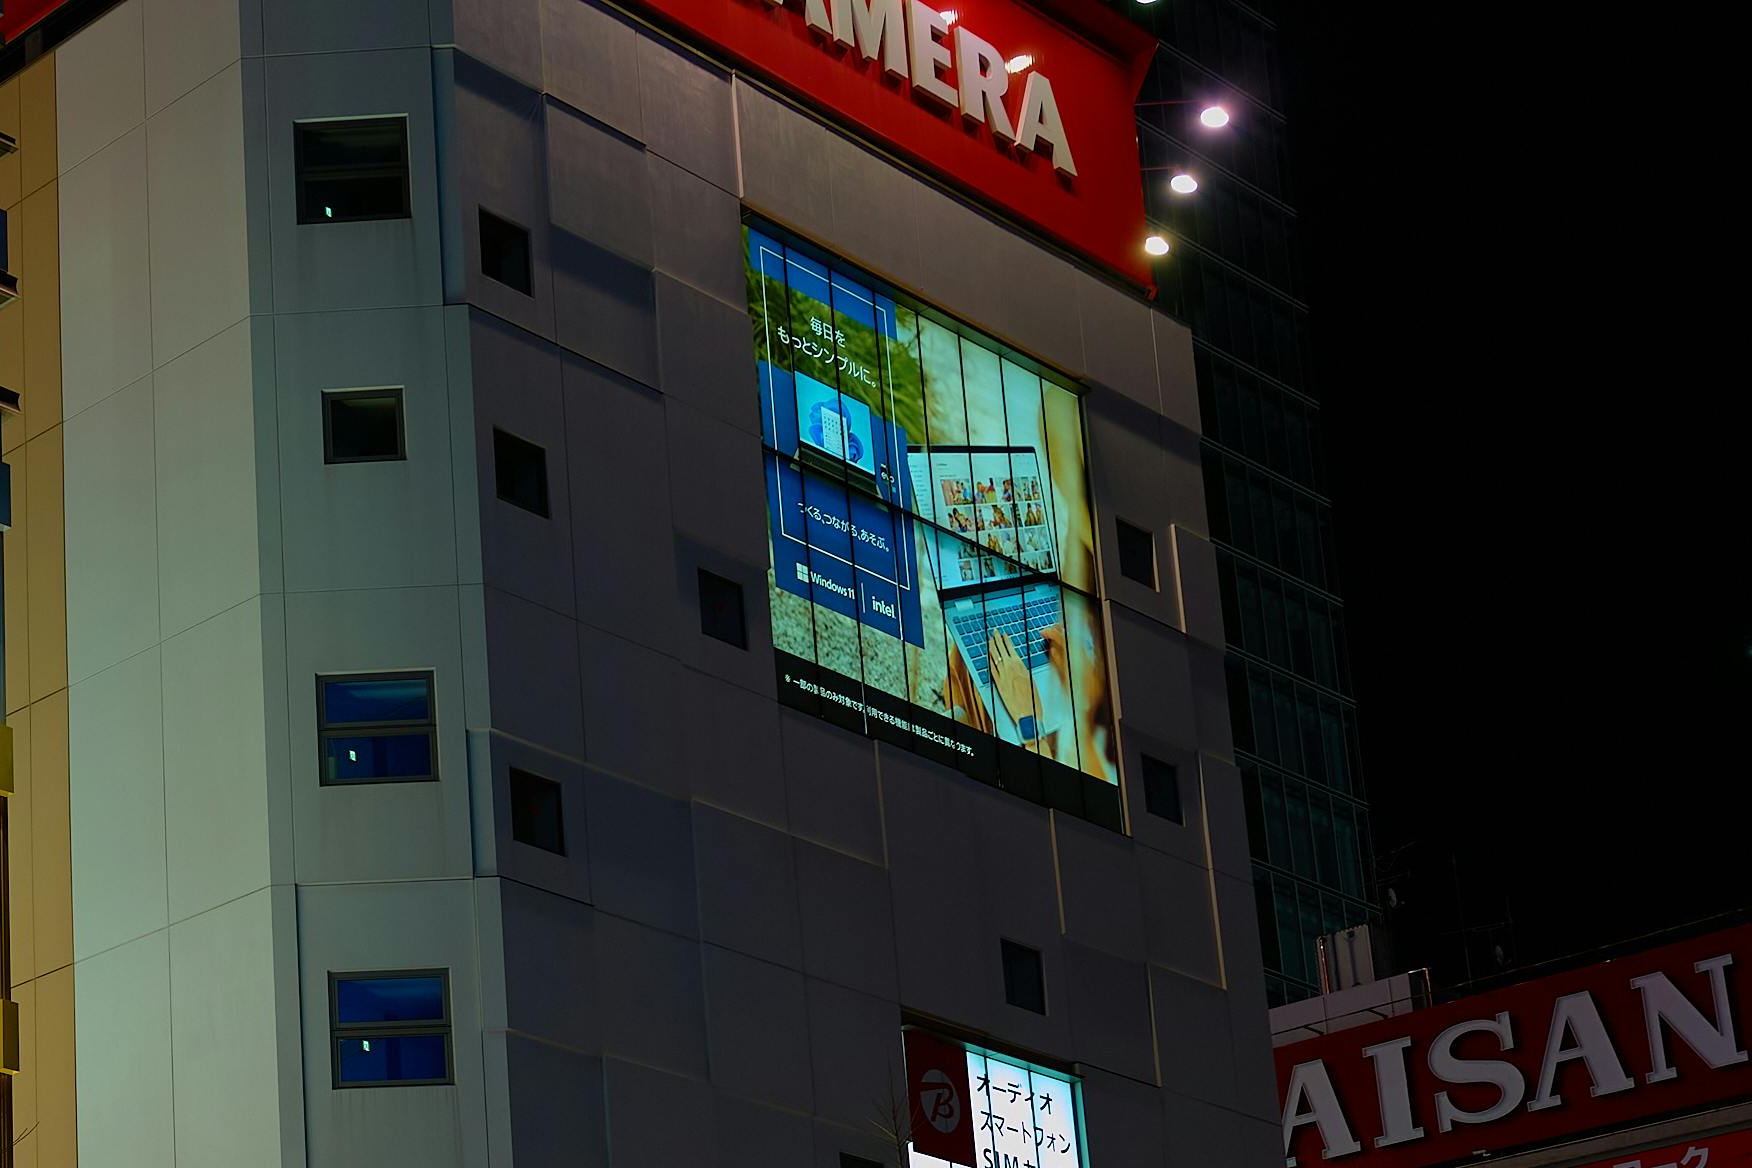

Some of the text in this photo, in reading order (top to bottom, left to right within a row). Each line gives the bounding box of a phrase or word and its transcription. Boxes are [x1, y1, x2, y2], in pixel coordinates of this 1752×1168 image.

[771, 0, 1079, 178] MERA
[777, 325, 877, 389] もっとシンプルに。
[810, 316, 846, 348] 毎日を
[810, 570, 848, 597] Windows
[1283, 953, 1748, 1168] AISAN
